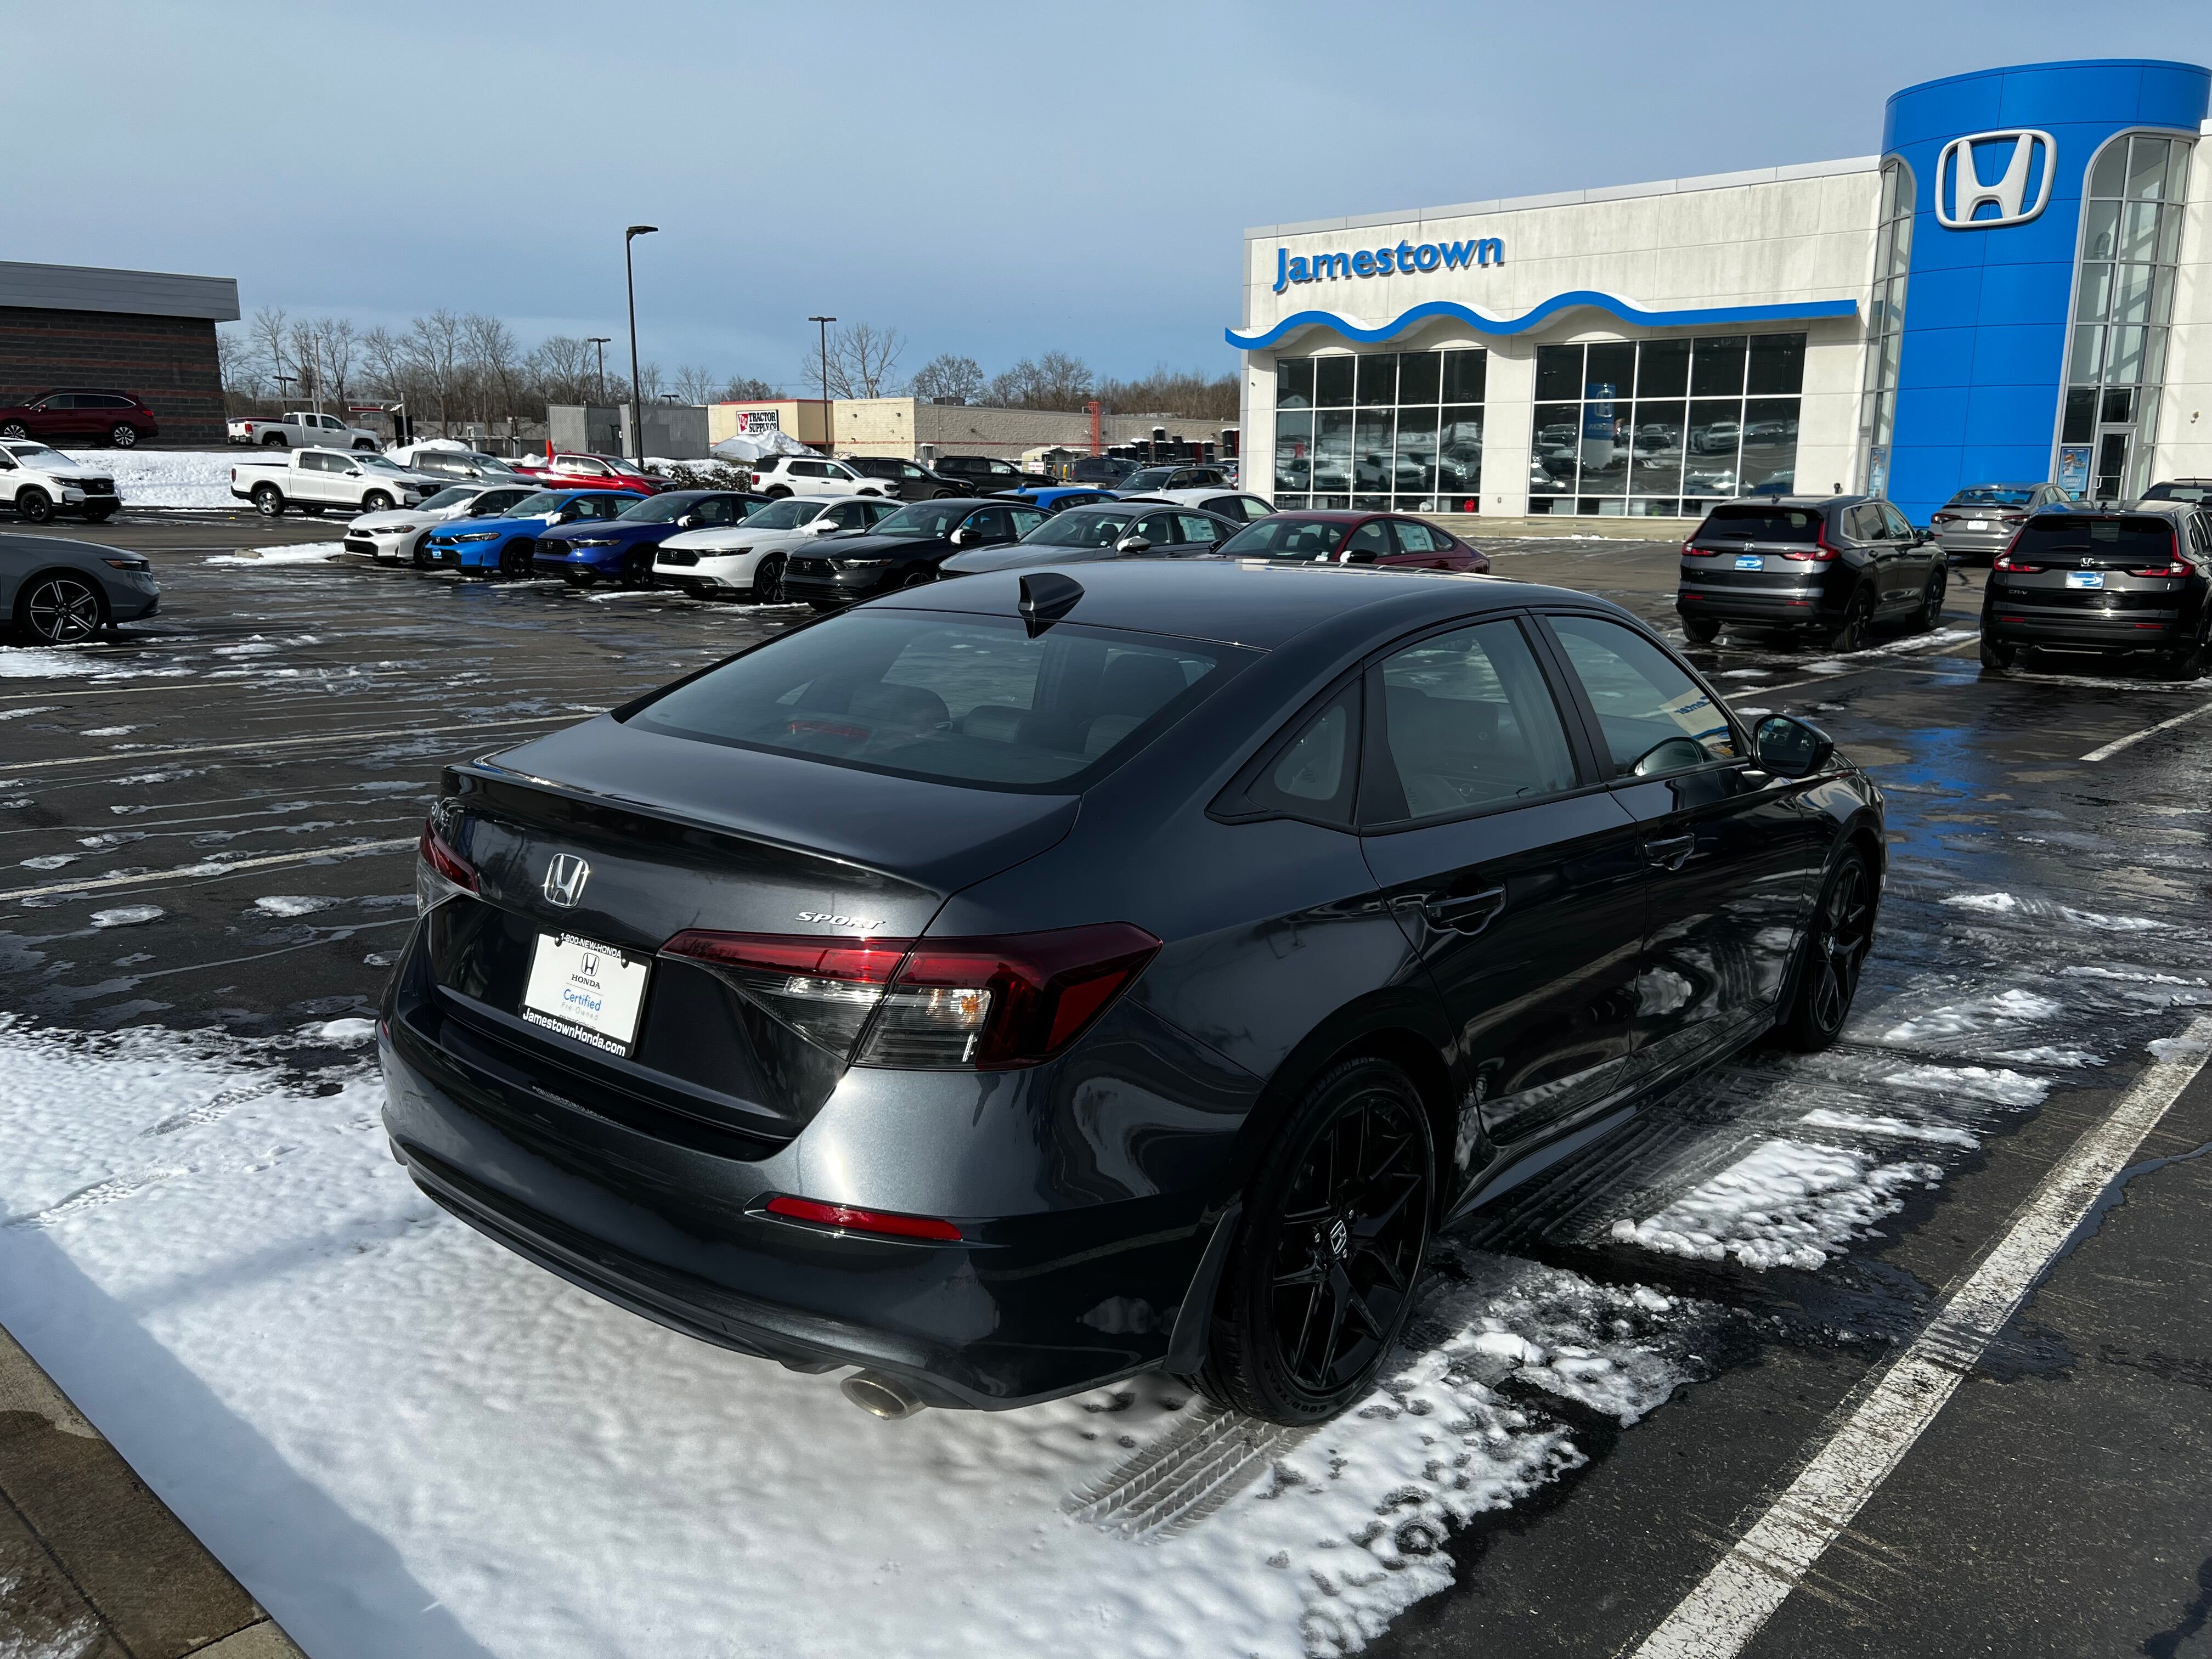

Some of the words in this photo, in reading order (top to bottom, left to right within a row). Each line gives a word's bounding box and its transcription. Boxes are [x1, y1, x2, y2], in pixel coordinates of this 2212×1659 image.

[1273, 237, 1504, 294] Jamestown
[748, 412, 776, 422] TRACTOR
[749, 423, 769, 432] SUPPLY
[795, 912, 885, 929] SPORT
[560, 933, 622, 958] 1-800-NEW-HONDA
[571, 974, 601, 989] HONDA
[563, 989, 602, 1012] Certified
[561, 1001, 599, 1020] Pre-Owned
[522, 1007, 625, 1057] JamestownHonda.com
